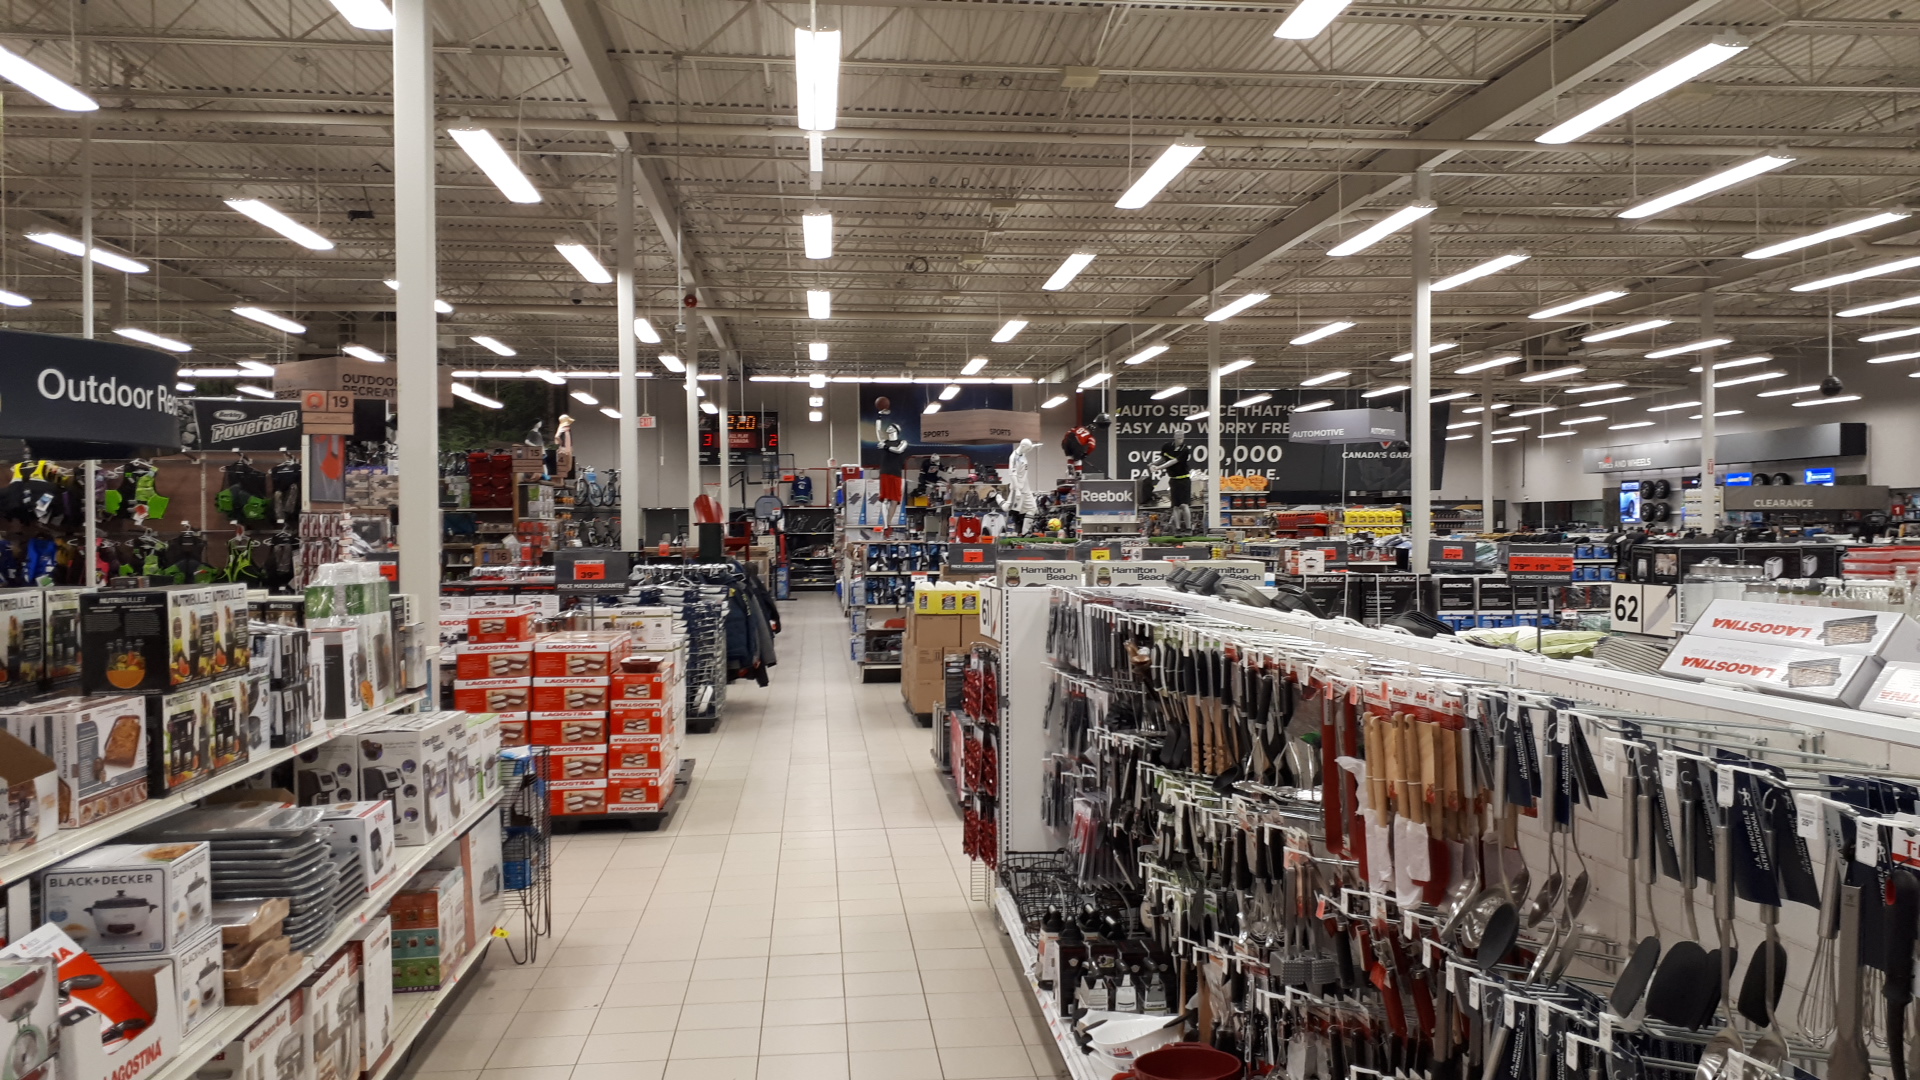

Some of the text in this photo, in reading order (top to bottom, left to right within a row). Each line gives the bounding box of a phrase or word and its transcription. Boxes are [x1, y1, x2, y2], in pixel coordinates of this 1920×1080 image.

[37, 368, 153, 410] Outdoor
[332, 396, 349, 408] 19
[1121, 403, 1296, 417] AUTO SERCE THAT'S
[211, 409, 298, 443] PowerBait
[989, 428, 1011, 436] SPORTS
[1116, 422, 1153, 434] EASY
[1161, 422, 1192, 434] AND
[1262, 422, 1290, 434] FRE
[1292, 428, 1345, 438] AUTOMOTIVE
[703, 434, 713, 446] 3
[769, 434, 778, 446] 2
[923, 430, 949, 438] SPORTS
[1127, 451, 1162, 463] OVE
[1342, 451, 1388, 459] CANADA'S
[1614, 459, 1626, 468] AND
[1627, 457, 1652, 467] WHEELS
[1081, 490, 1133, 502] Reebok
[1753, 499, 1814, 507] CLEARANCE
[1021, 566, 1066, 574] Hamilton
[1112, 566, 1157, 574] Hamilton
[99, 596, 146, 604] NUTRIBULLET
[172, 592, 212, 607] NUTRIBULLET
[212, 587, 244, 602] UTRIBULLET
[0, 595, 39, 612] TRIBULLET
[1615, 594, 1638, 622] 62
[1712, 617, 1812, 638] LAGOSTINA
[1680, 656, 1778, 679] LAGOSTINA
[465, 679, 518, 687] LAGOSTINA
[1742, 810, 1759, 853] HENCKELS
[1750, 811, 1770, 871] INTERNATIONAL
[172, 852, 207, 880] BLACK+DECKER
[50, 874, 154, 888] BLACK+DECKER
[182, 937, 219, 968] BLACK+DECKER
[316, 963, 346, 1000] KitchenAid
[249, 1010, 287, 1052] KitchenAid
[104, 1037, 162, 1080] AGOSTINA
